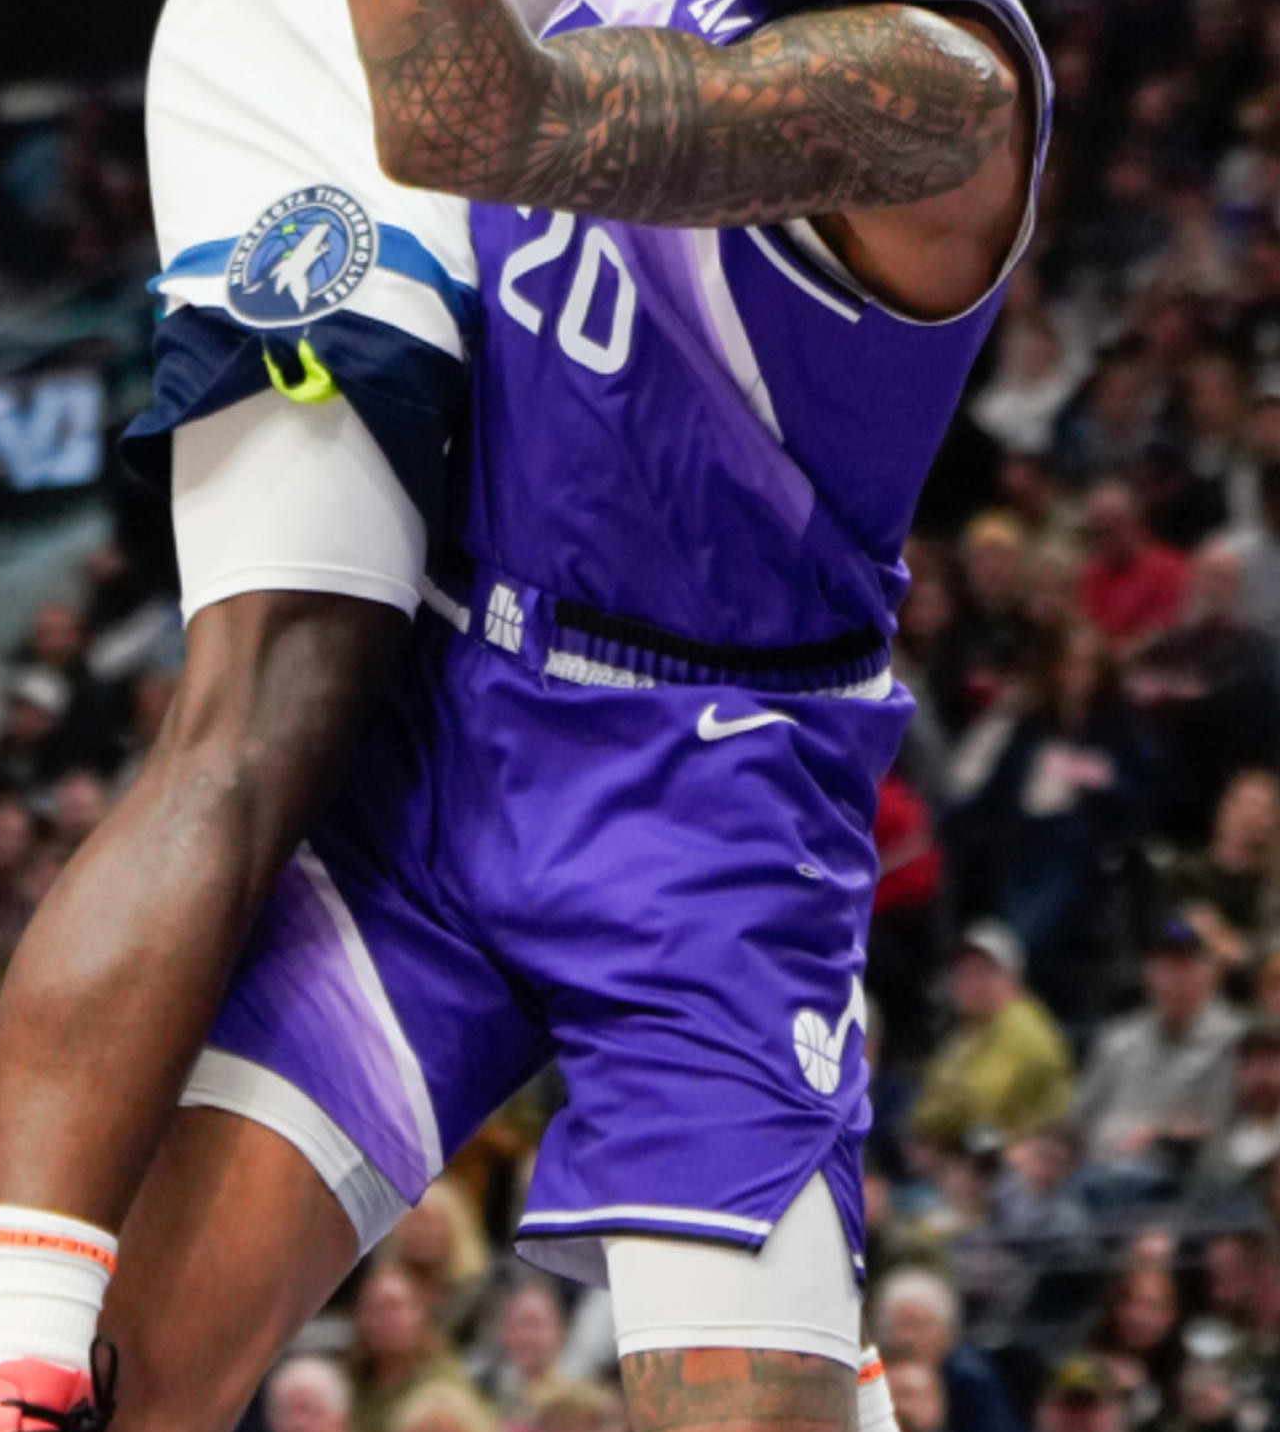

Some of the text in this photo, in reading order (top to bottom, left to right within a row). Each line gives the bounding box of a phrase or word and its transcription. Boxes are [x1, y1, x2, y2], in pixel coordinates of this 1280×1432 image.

[230, 187, 372, 306] MINNESOTA TIMBERWOLVES
[500, 204, 636, 375] 20
